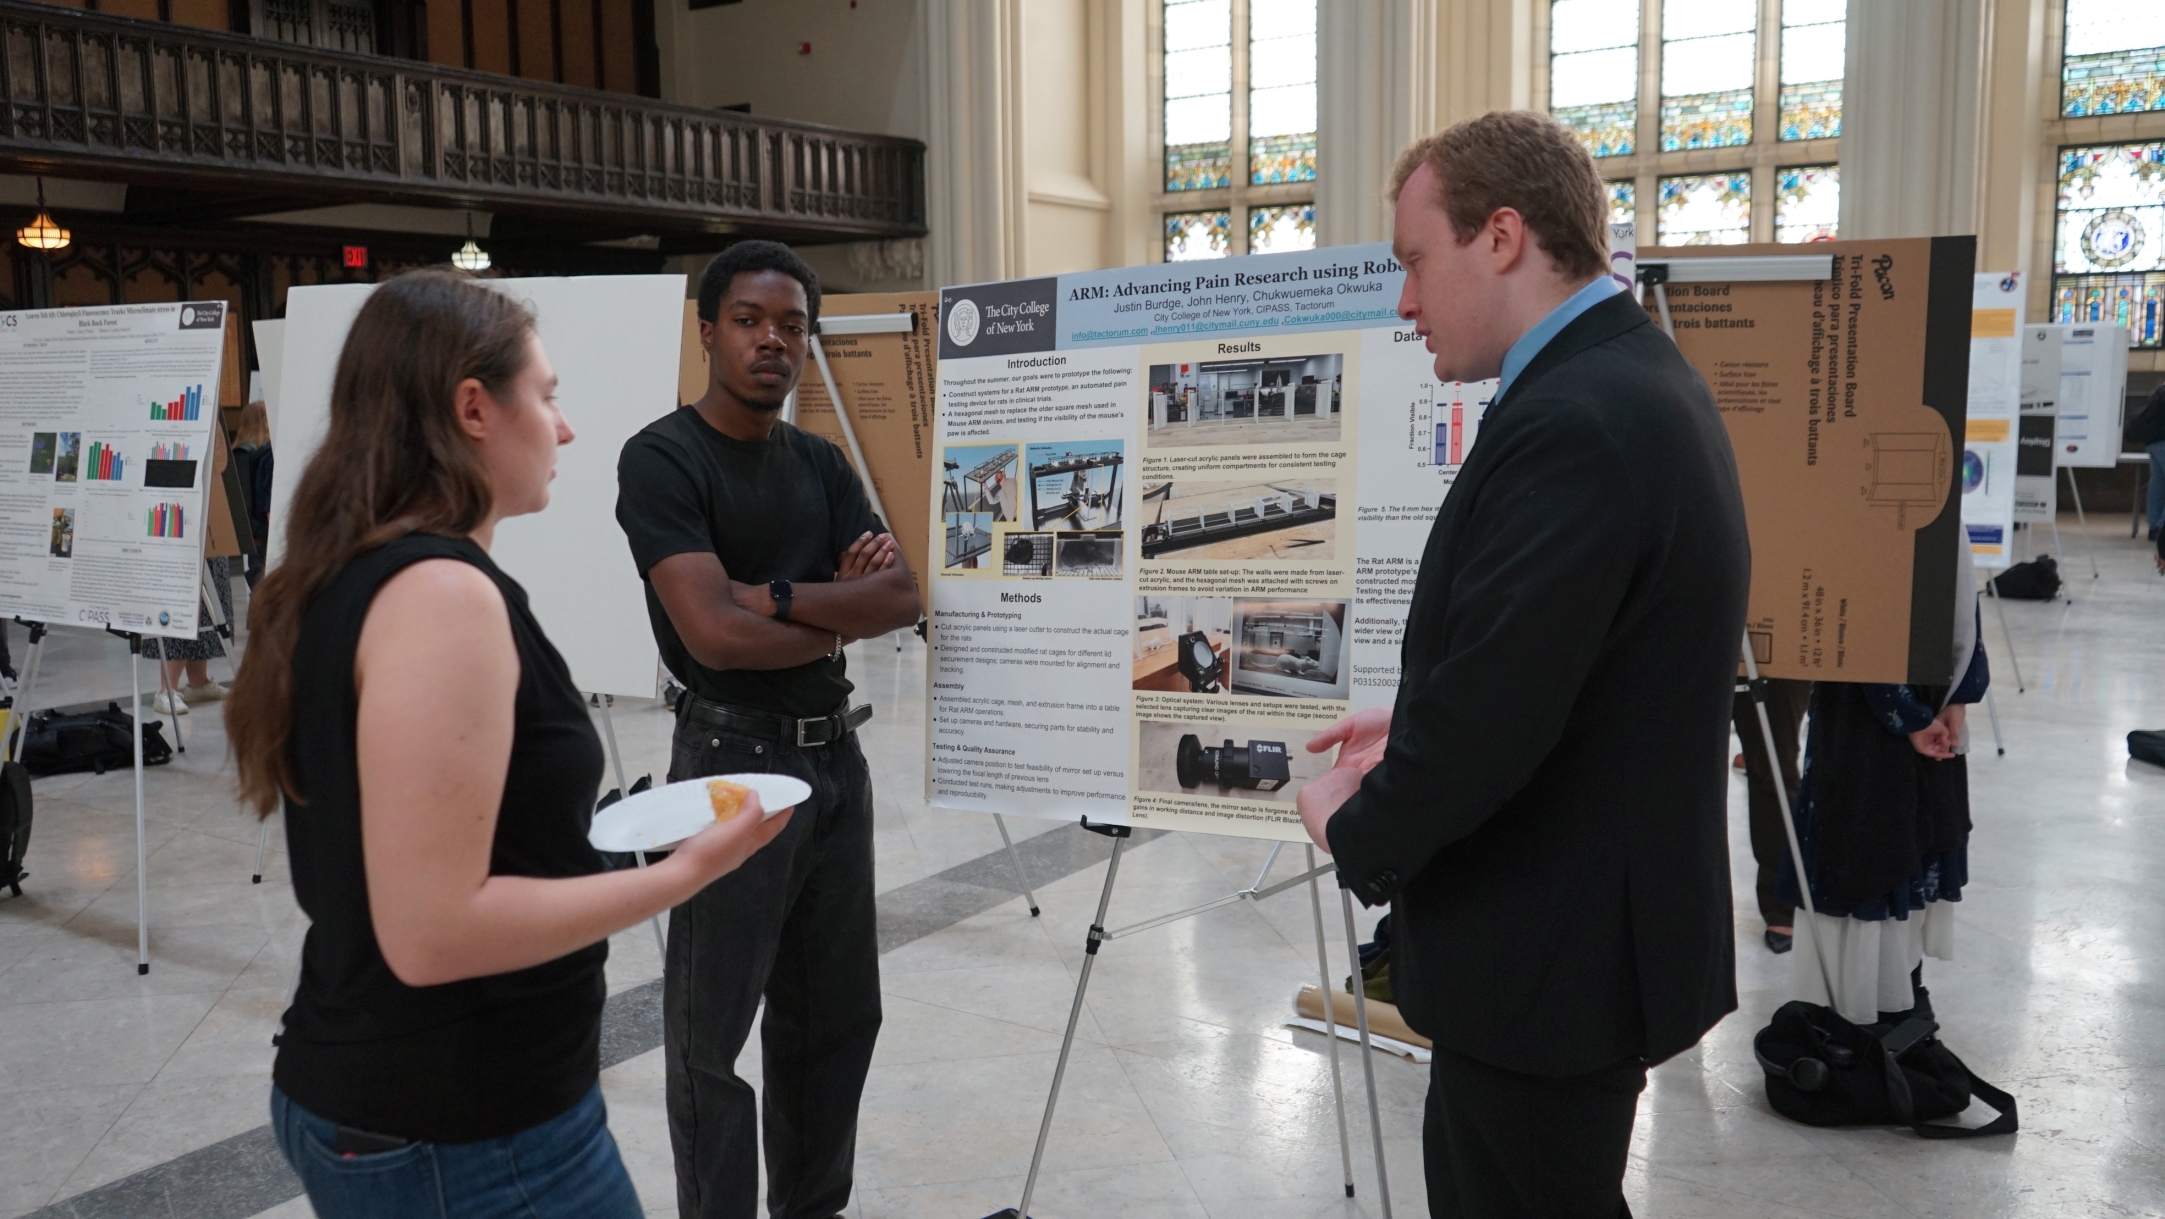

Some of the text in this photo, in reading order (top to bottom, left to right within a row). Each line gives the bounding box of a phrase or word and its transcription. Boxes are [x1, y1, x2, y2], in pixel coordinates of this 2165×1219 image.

[345, 246, 366, 267] EXIT
[1069, 286, 1109, 301] ARM:
[1113, 278, 1191, 297] Advancing
[1195, 274, 1230, 290] Pain
[1234, 266, 1308, 286] Research
[1313, 263, 1359, 280] using
[1871, 254, 1895, 300] Pacon
[1113, 281, 1382, 313] Justin Burdge, John Henry, Chukwuemeka Okwuka
[1694, 285, 1730, 296] Board
[985, 302, 1050, 319] The City College
[1154, 301, 1335, 323] City College of New York, CIPASS, Tactorum
[1828, 304, 1841, 330] para
[986, 320, 1034, 335] of New York
[1674, 317, 1755, 328] trois battants
[1072, 328, 1148, 341] info@tactorum.com
[1394, 332, 1422, 342] Data
[1808, 311, 1825, 374] d'affichage
[1844, 254, 1863, 417] Tri-Fold Presentation Board
[843, 349, 872, 358] battants
[919, 303, 936, 394] Tri-Fold Presentation
[1218, 341, 1261, 354] Results
[903, 345, 916, 390] d'affichage
[1007, 355, 1066, 369] Introduction
[911, 339, 929, 427] para presentaciones
[943, 378, 976, 387] Throughout
[1022, 374, 1038, 382] goals
[1061, 370, 1090, 379] prototype
[1827, 335, 1840, 423] presentaciones
[977, 389, 1000, 397] systems
[1041, 385, 1070, 393] prototype,
[1080, 381, 1112, 389] automated
[1809, 389, 1822, 415] trois
[911, 401, 919, 421] trois
[913, 424, 923, 459] battants
[1807, 419, 1821, 466] battants
[1375, 567, 1418, 576] prototype's
[1000, 592, 1042, 603] Methods
[934, 610, 980, 620] Manufacturing
[986, 611, 1022, 620] Prototyping
[1354, 617, 1400, 627] Additionally,
[1353, 664, 1394, 674] Supported
[933, 681, 964, 691] Assembly
[932, 742, 955, 752] Testing
[962, 744, 983, 754] Quality
[983, 746, 1016, 756] Assurance
